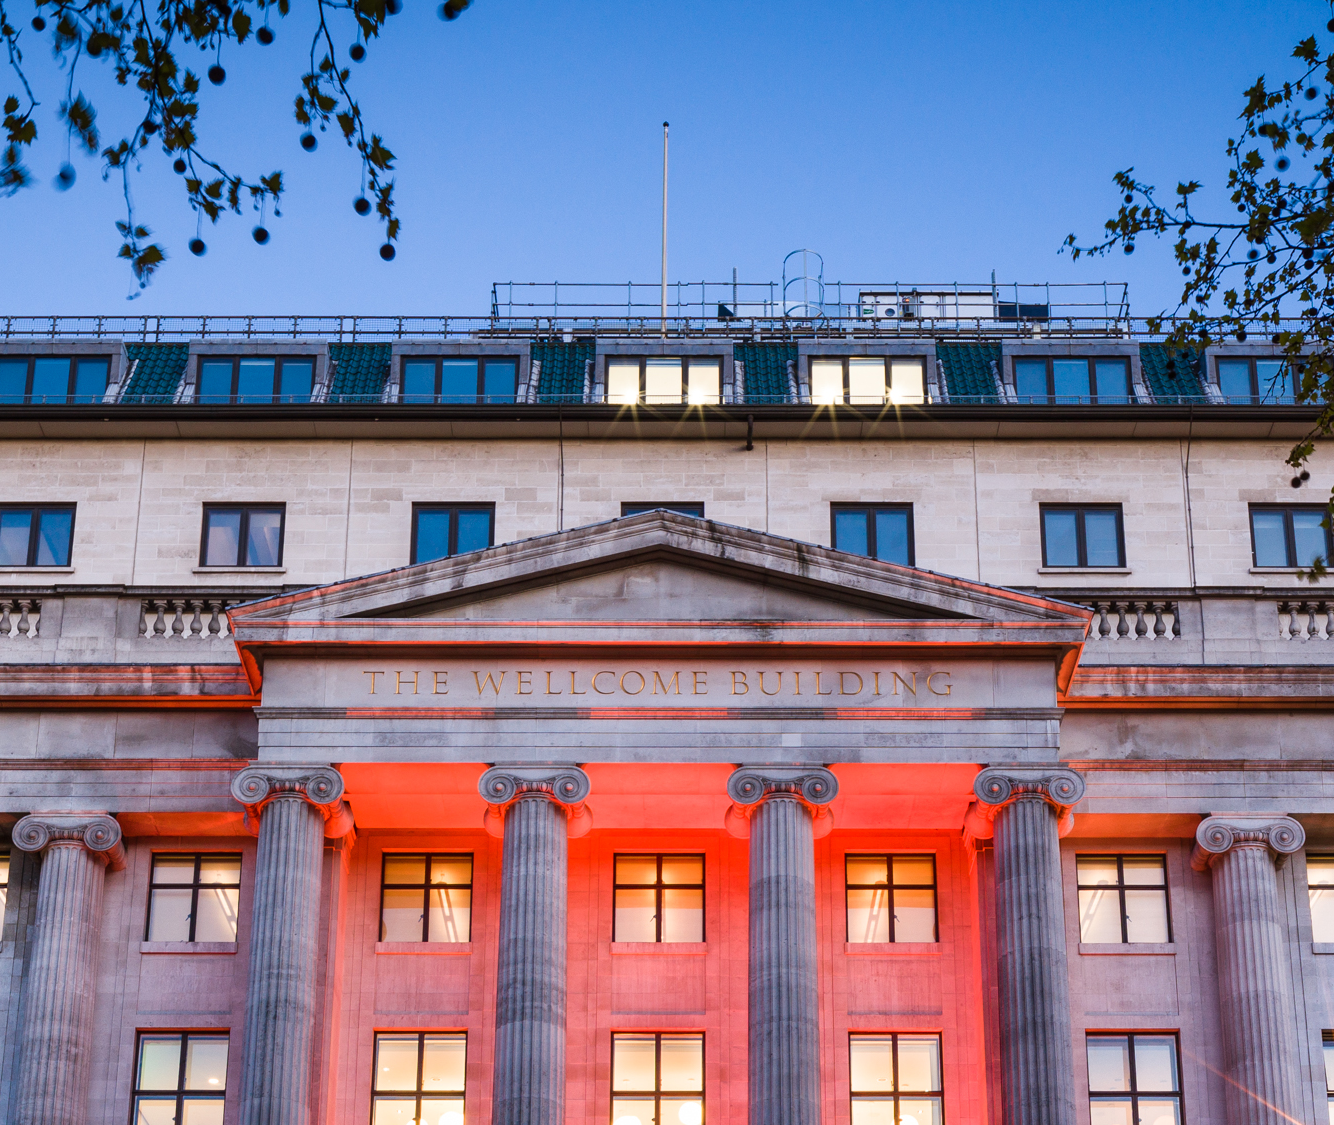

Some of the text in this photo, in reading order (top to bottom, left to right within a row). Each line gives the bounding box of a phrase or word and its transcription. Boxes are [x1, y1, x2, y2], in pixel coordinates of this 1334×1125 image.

[362, 670, 954, 696] THE WELLCOME BUILDING
